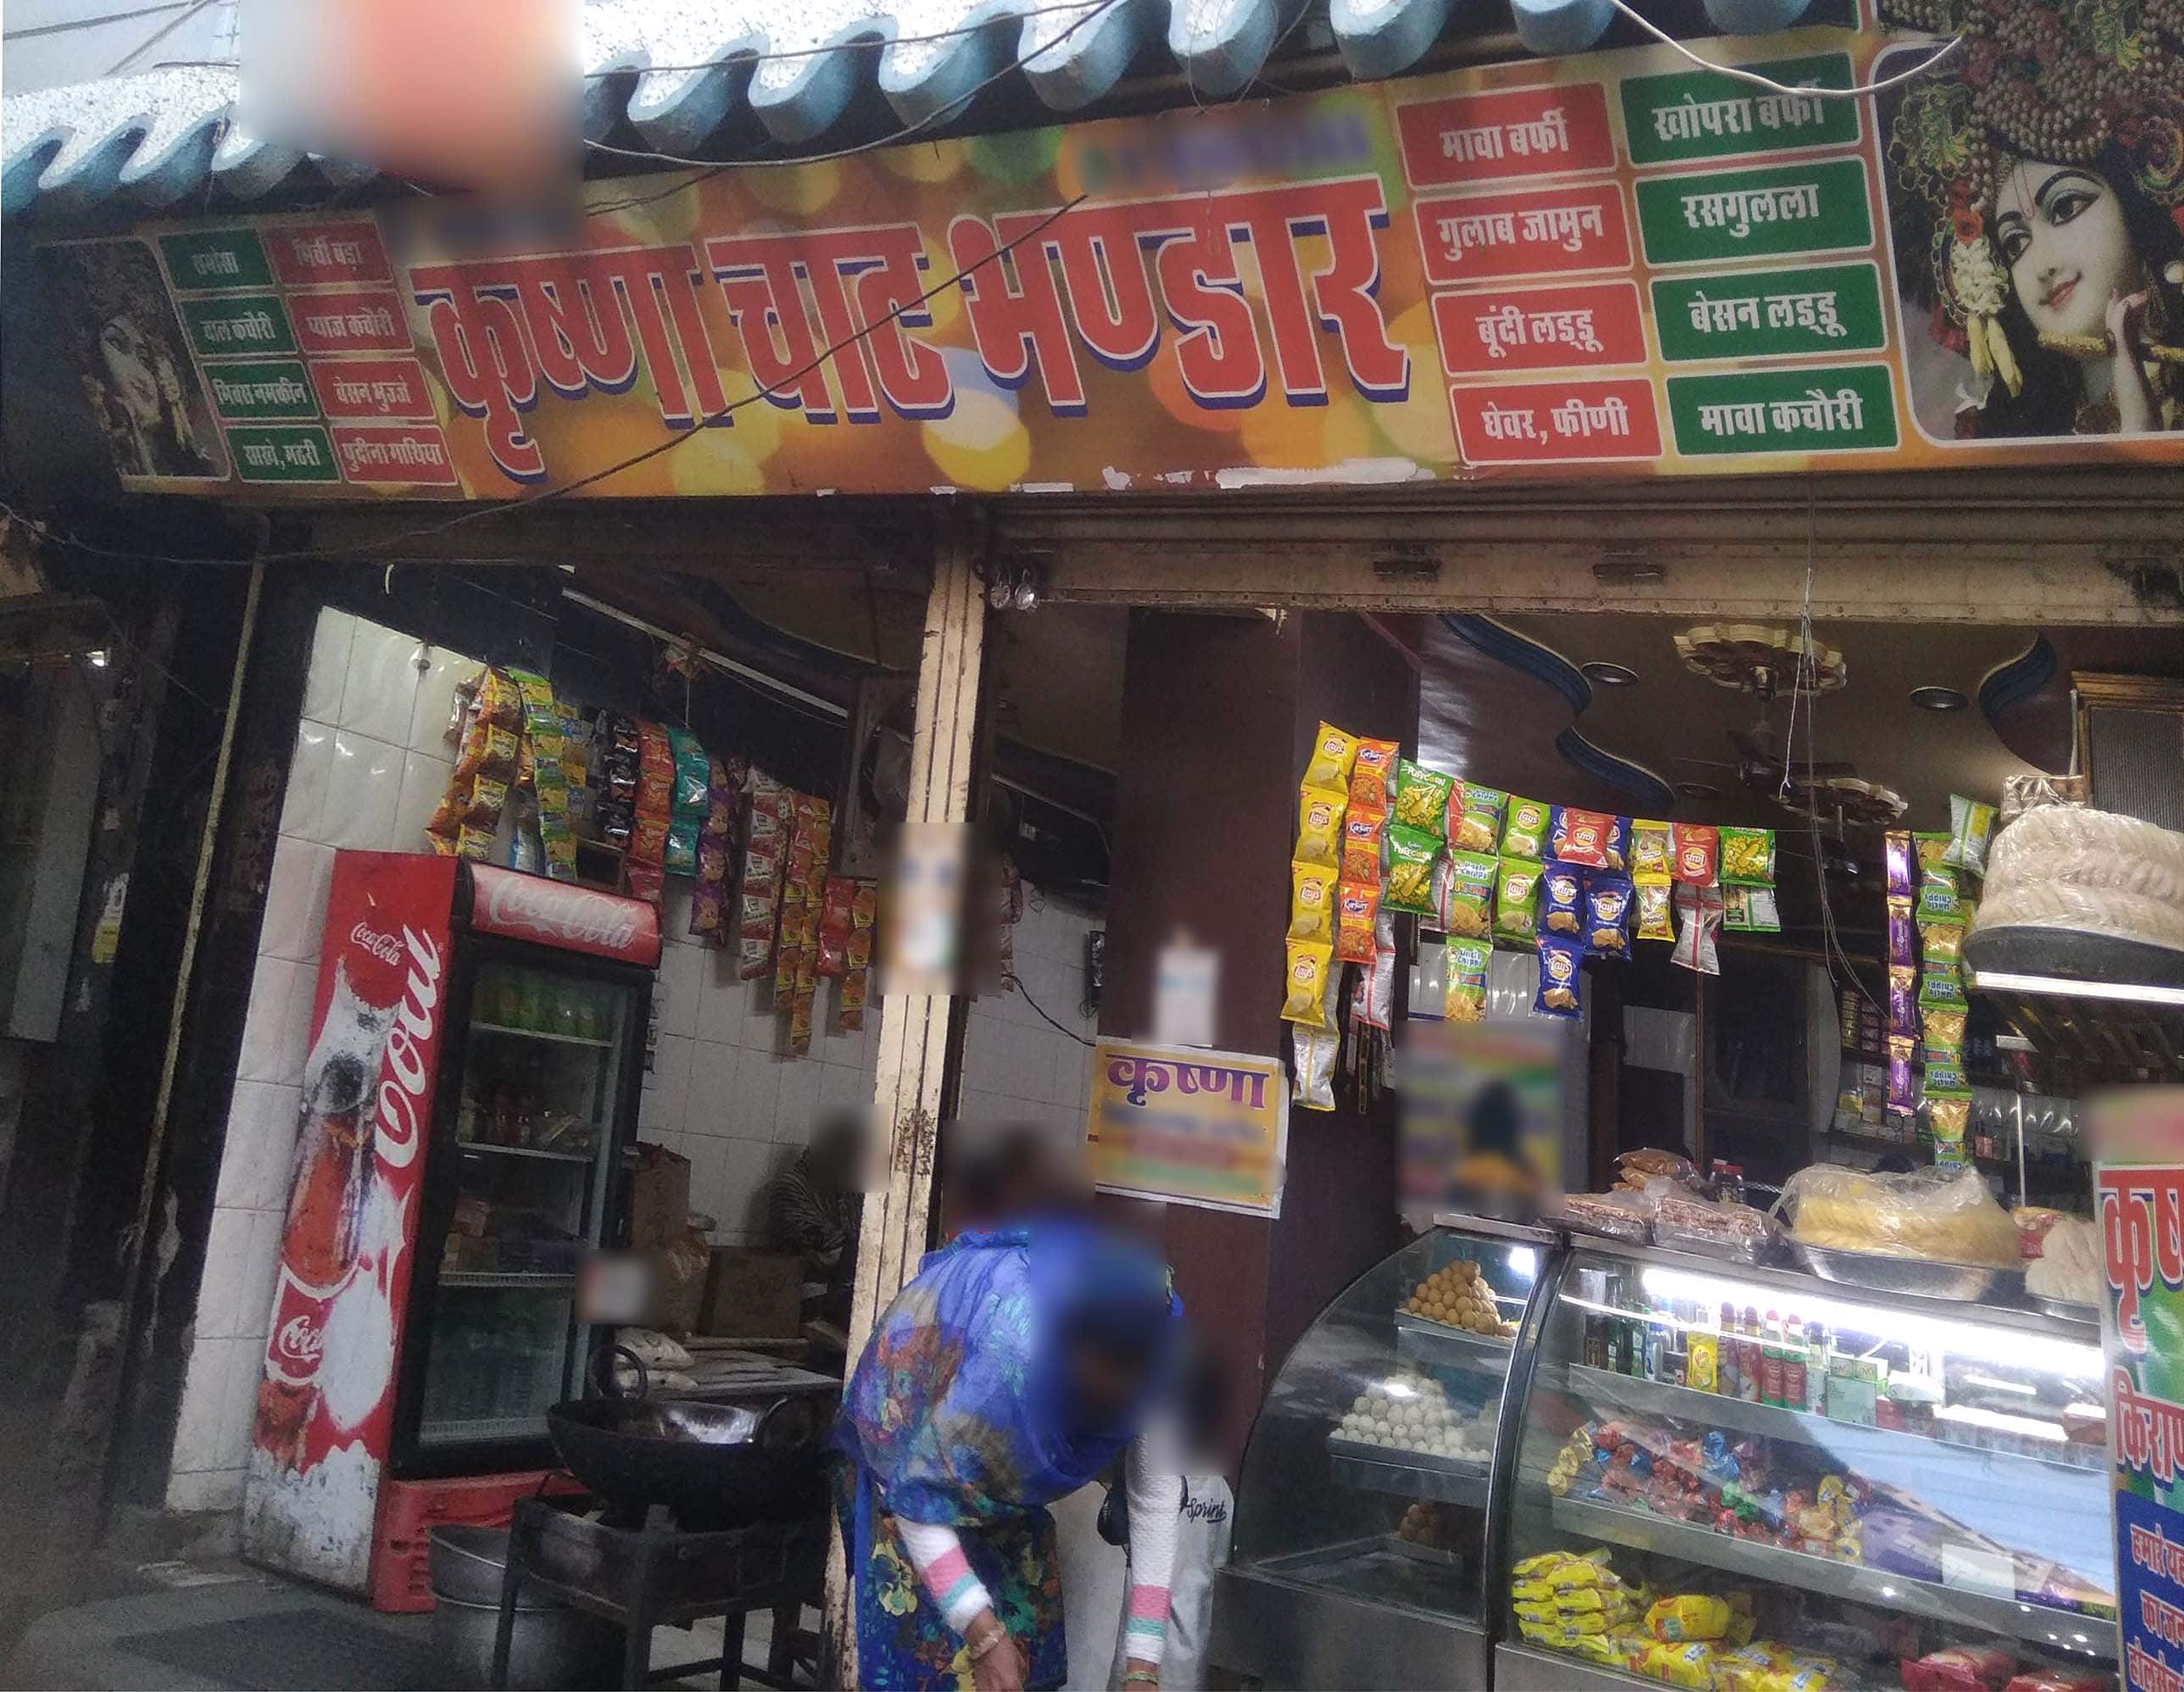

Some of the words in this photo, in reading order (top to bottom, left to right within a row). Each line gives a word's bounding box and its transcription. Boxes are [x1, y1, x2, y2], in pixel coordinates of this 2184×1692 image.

[1440, 126, 1503, 164] मावा
[1507, 106, 1570, 155] बर्फी
[1652, 93, 1752, 142] खोपरा
[1436, 210, 1514, 261] गुलाब
[1519, 203, 1605, 252] जामुन
[409, 243, 735, 484] कृष्णा
[707, 222, 954, 426] चाट
[948, 174, 1412, 419] भण्डार
[1474, 304, 1527, 359] बूंदी
[1528, 309, 1605, 353] लड्डू
[1687, 290, 1758, 334] बेसन
[1763, 291, 1847, 337] लड्डू
[1552, 397, 1630, 437] फीणी
[1697, 403, 1766, 437] मावा
[1767, 387, 1864, 435] कचौरी
[1105, 1053, 1273, 1110] कृष्णा
